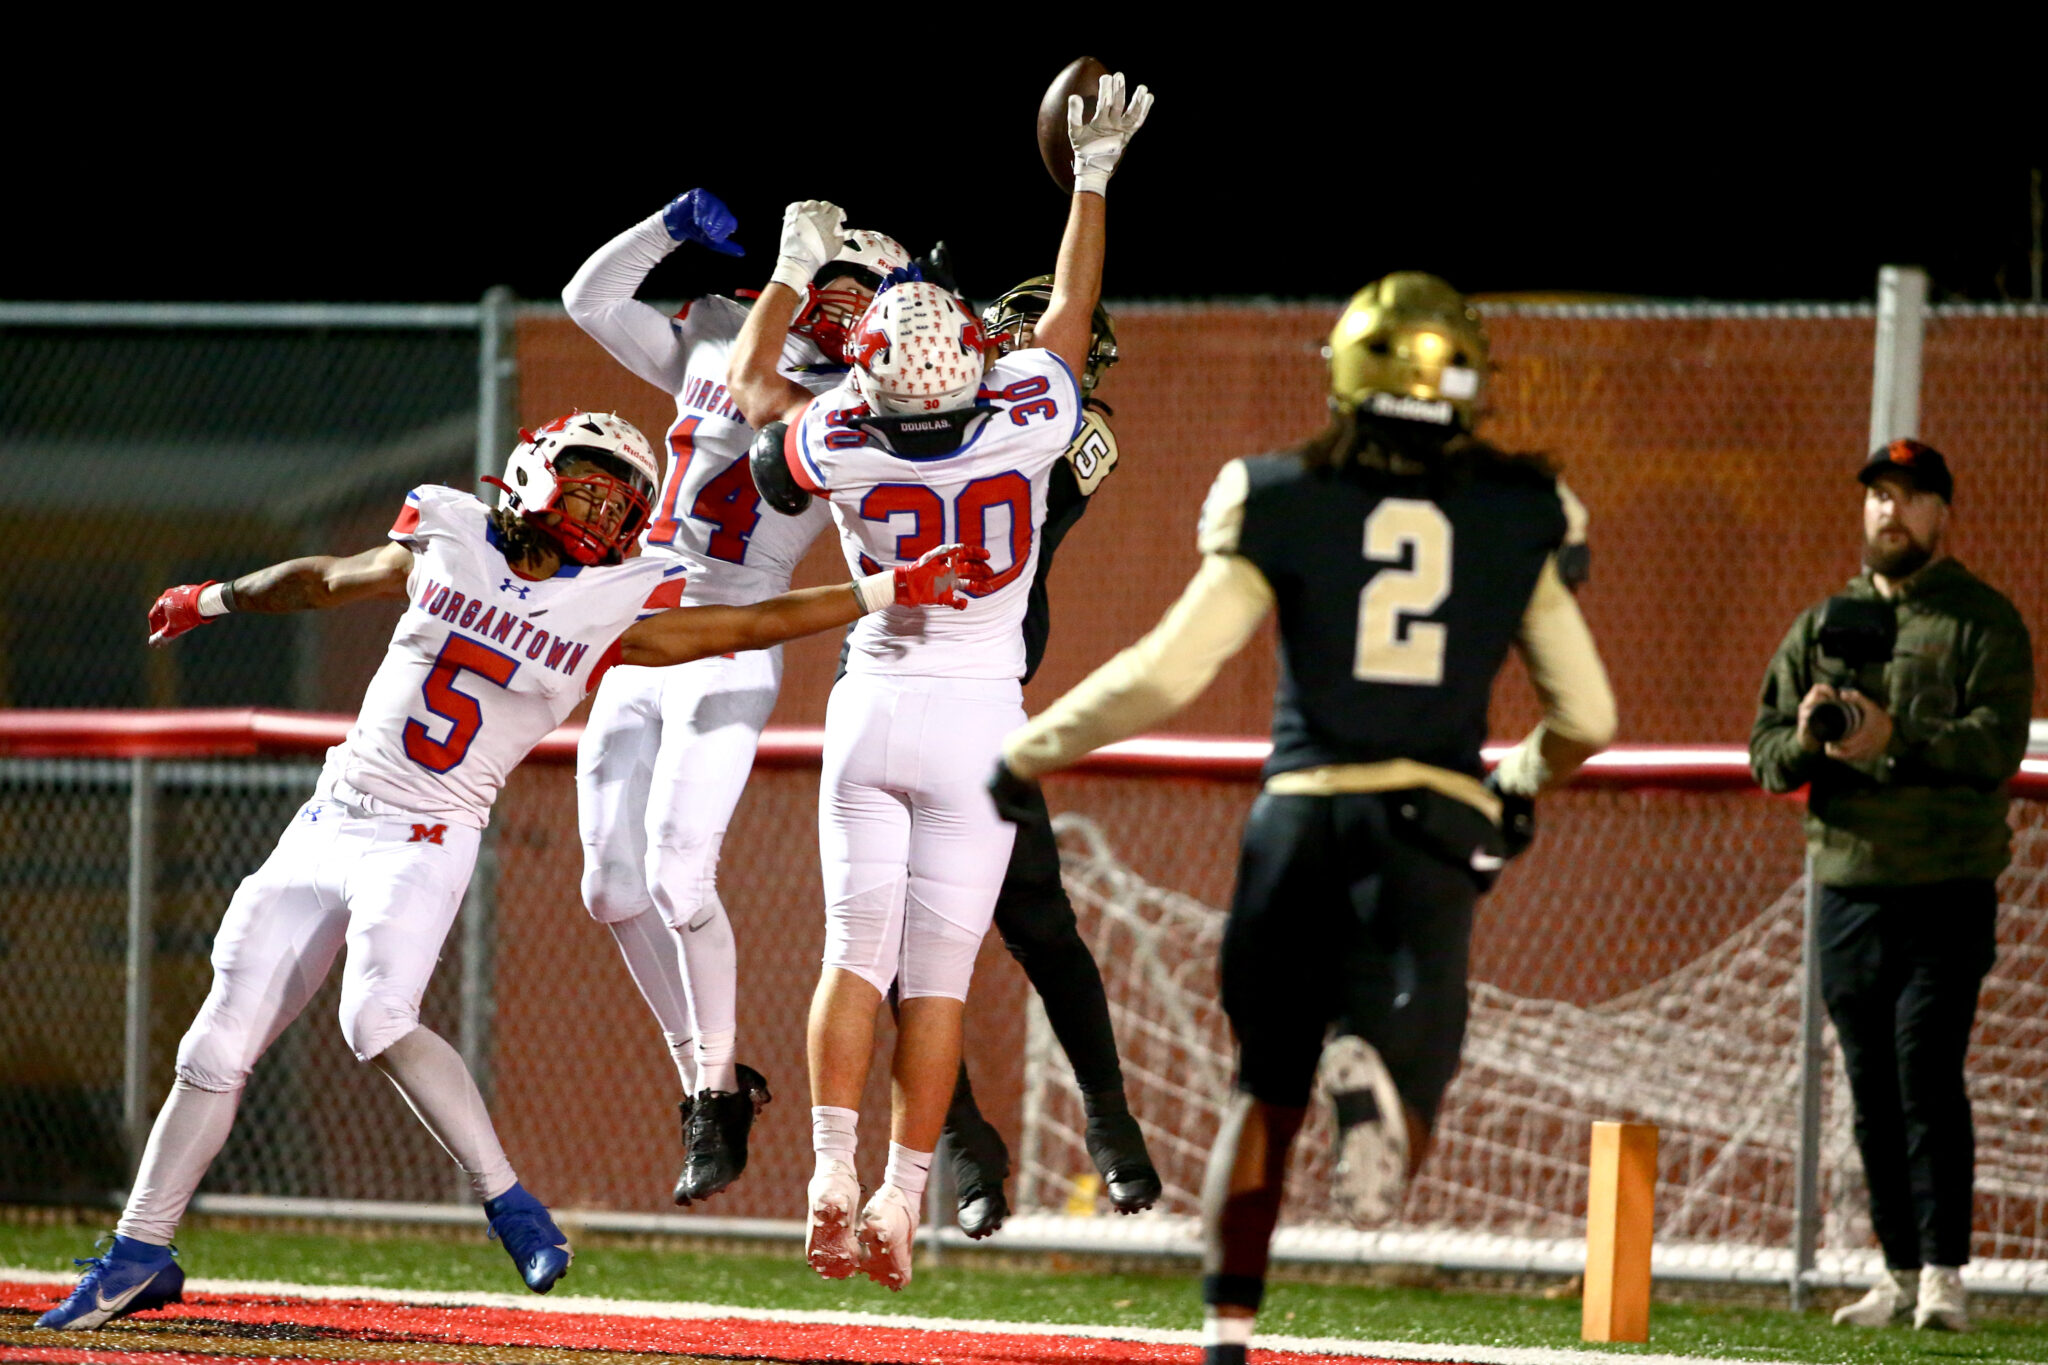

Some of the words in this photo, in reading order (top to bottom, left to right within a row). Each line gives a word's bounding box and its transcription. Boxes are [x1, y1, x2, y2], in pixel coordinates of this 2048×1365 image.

[923, 398, 940, 410] 30
[1003, 375, 1058, 427] 30
[647, 414, 762, 566] 14
[860, 469, 1034, 599] 30
[1354, 498, 1454, 686] 2
[402, 630, 522, 776] 5
[407, 823, 449, 846] M
